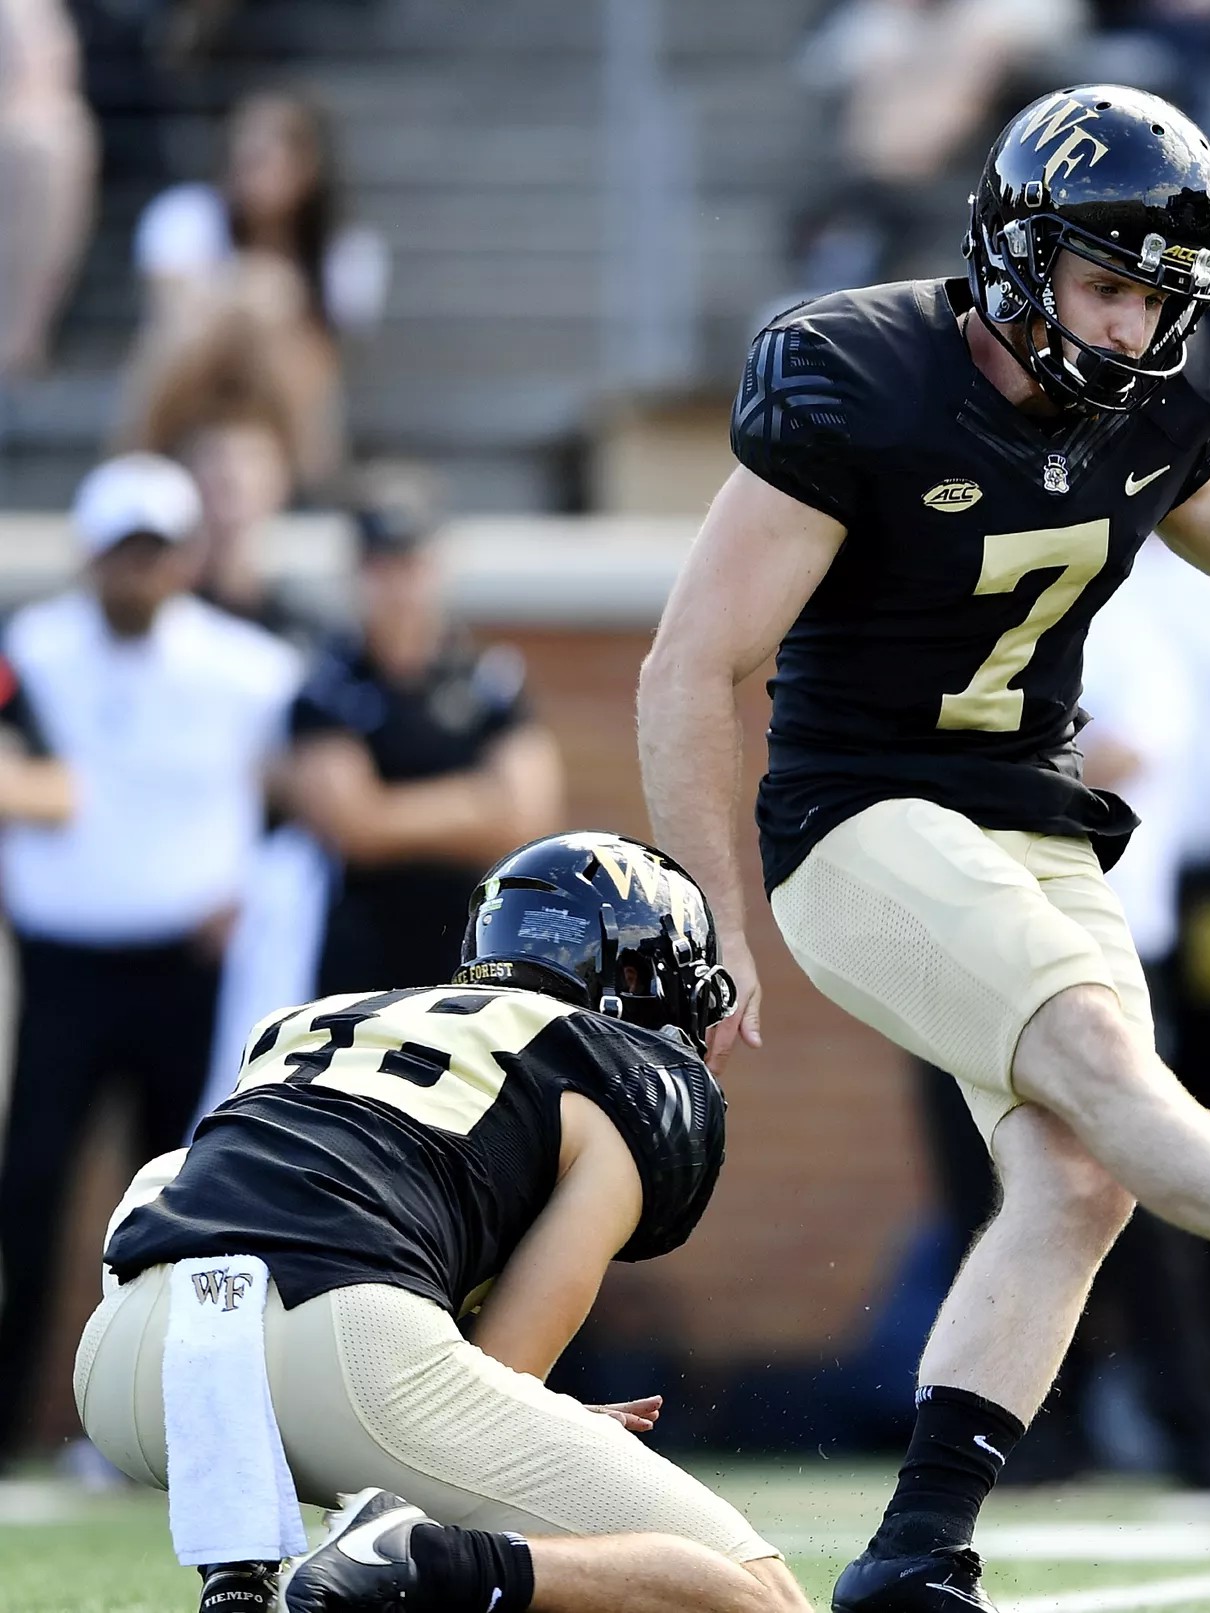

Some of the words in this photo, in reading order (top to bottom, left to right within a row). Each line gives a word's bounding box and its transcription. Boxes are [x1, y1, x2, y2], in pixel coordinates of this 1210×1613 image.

[1019, 97, 1109, 191] WF
[1162, 244, 1199, 261] ACC
[930, 486, 977, 501] ACC
[935, 518, 1110, 732] 7
[470, 962, 513, 982] FOREST
[191, 1267, 253, 1312] WF
[204, 1591, 264, 1608] TIEMPO
